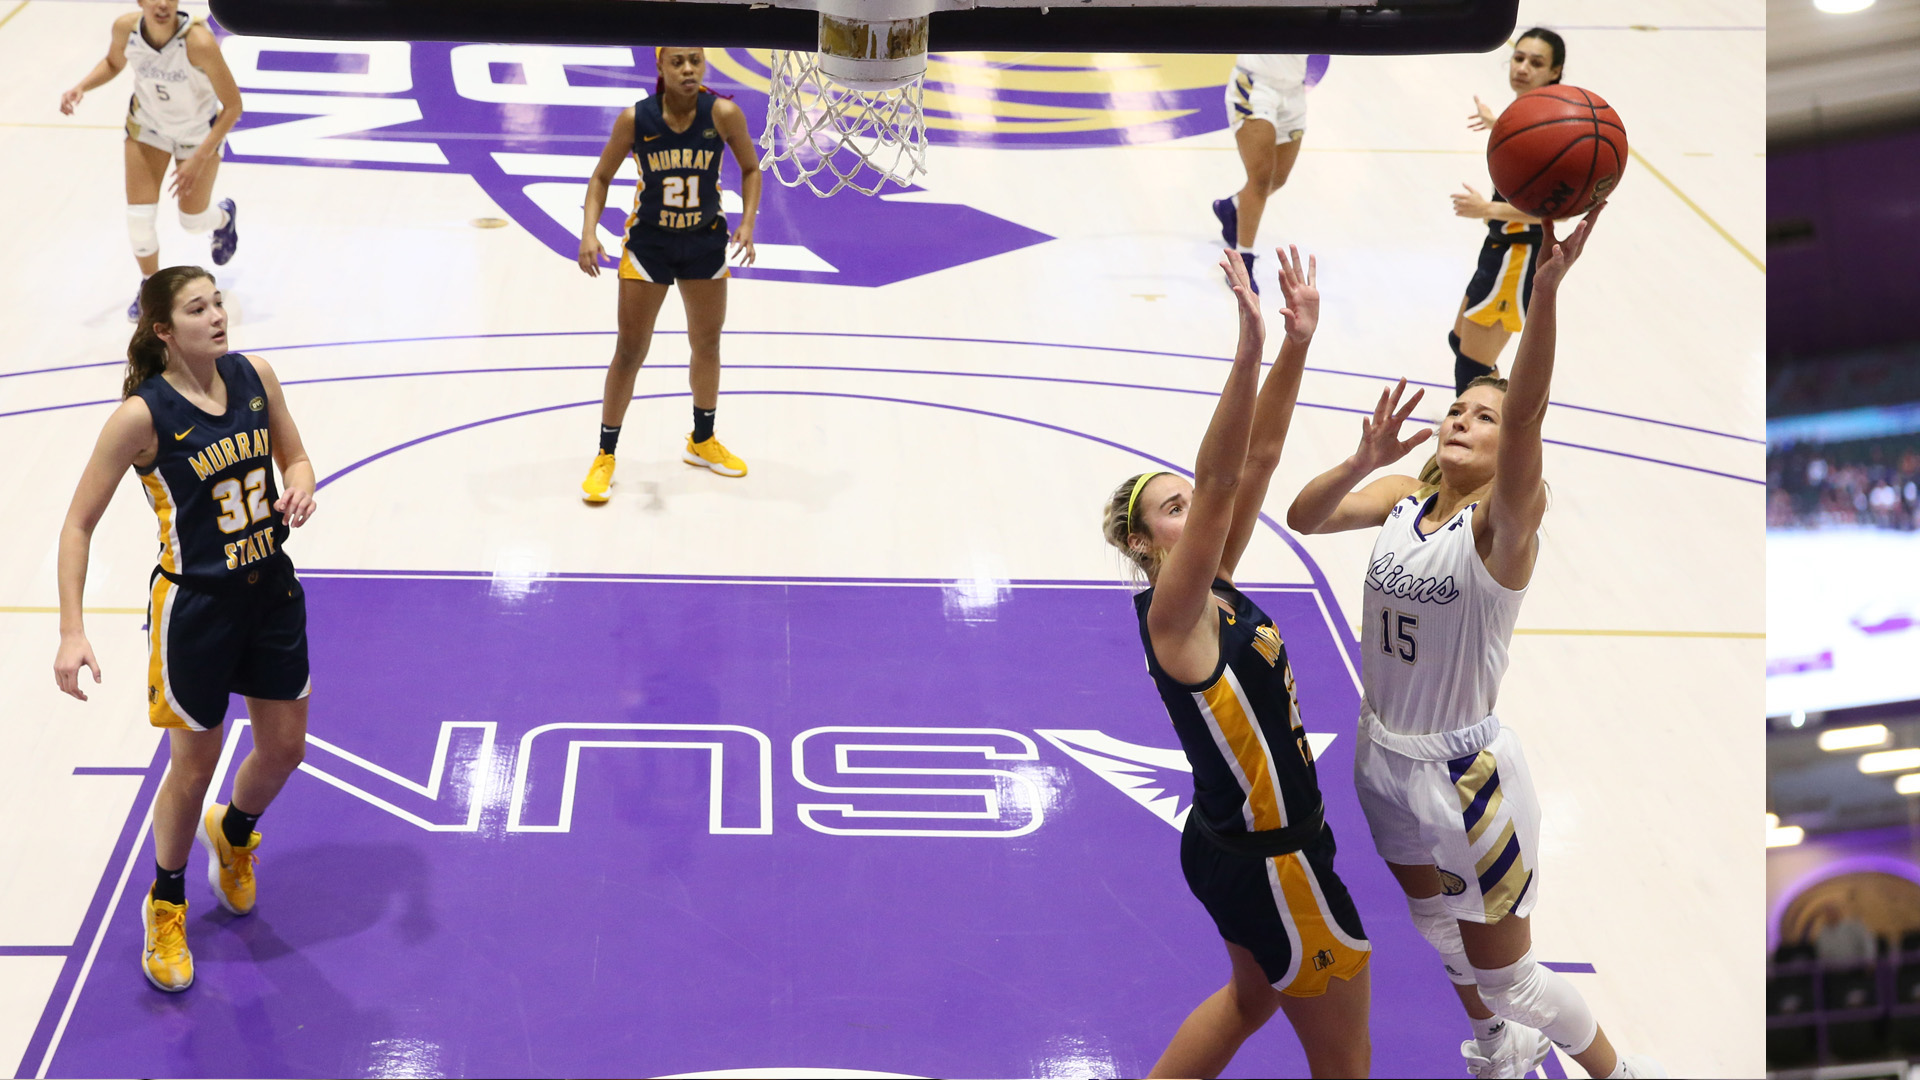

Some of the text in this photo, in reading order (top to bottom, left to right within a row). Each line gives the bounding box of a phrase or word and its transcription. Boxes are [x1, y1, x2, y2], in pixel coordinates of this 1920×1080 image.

[155, 84, 170, 102] 5
[647, 149, 714, 172] MURRAY
[662, 175, 700, 209] 21
[658, 209, 702, 229] STATE
[188, 428, 269, 482] MURRAY
[211, 466, 271, 535] 32
[224, 526, 276, 570] STATE
[1364, 552, 1460, 605] Lions
[1380, 607, 1419, 667] 15
